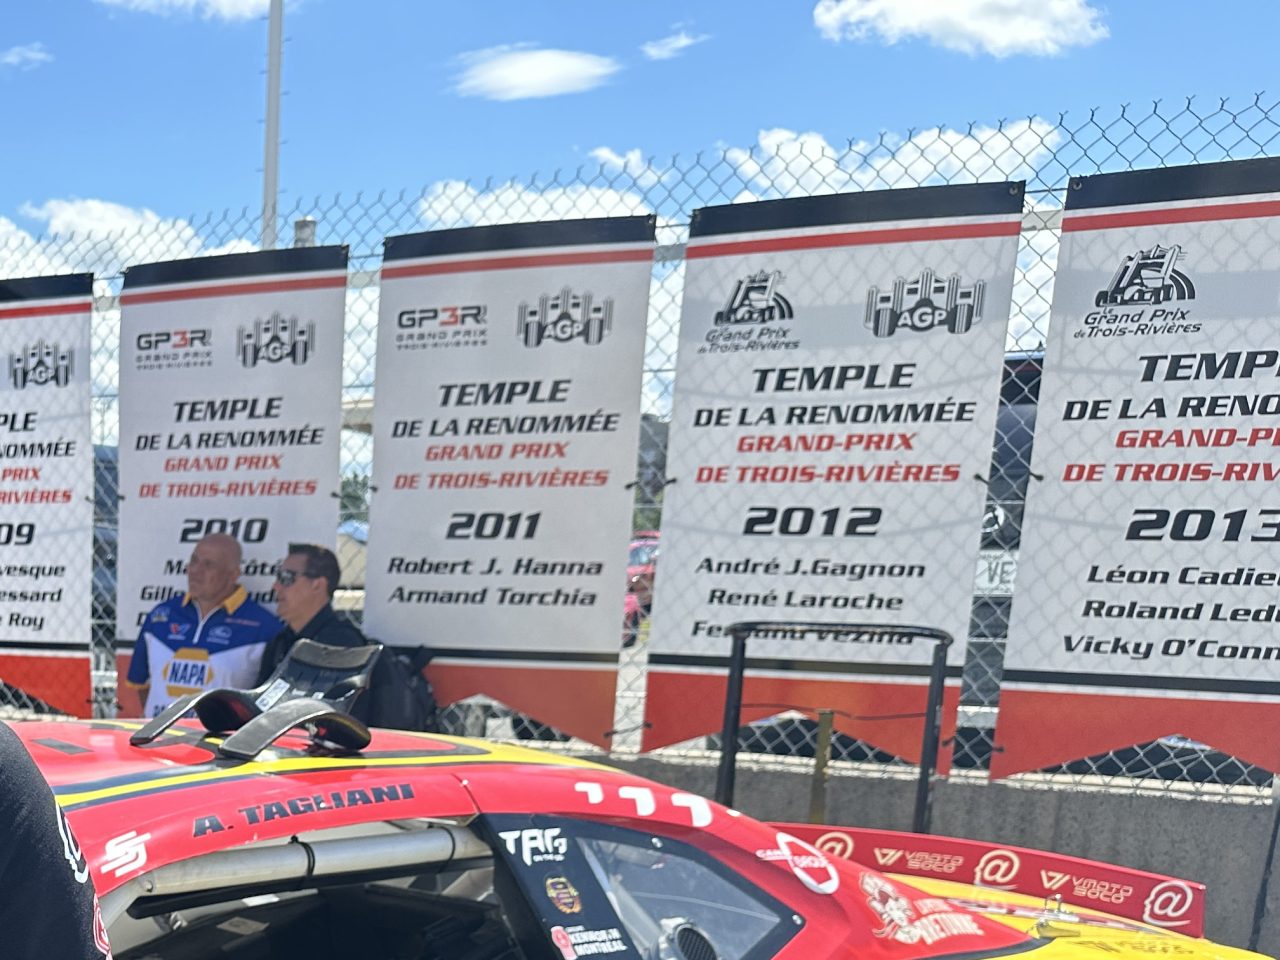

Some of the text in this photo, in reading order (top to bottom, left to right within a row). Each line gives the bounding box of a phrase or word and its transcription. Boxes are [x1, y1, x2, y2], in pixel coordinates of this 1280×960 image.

[898, 309, 947, 328] AGP
[1084, 308, 1190, 326] Grand Prix
[1087, 323, 1202, 337] Trois-Rivières
[1138, 350, 1280, 382] TEMP
[753, 363, 917, 393] TEMPLE
[439, 379, 571, 407] TEMPLE
[173, 397, 284, 423] TEMPLE
[693, 397, 977, 427] DE LA RENOMMÉE
[1062, 400, 1112, 421] DE
[1118, 398, 1167, 419] LA
[391, 409, 620, 438] DE LA RENOMMÉE
[136, 424, 324, 451] DE LA RENOMMÉE
[736, 433, 918, 453] GRAND-PRIX
[164, 453, 283, 473] GRAND PRIX
[425, 441, 570, 462] GRAND PRIX
[1, 466, 42, 481] PRIX
[393, 467, 610, 490] DE TROIS-RIVIÈRES
[695, 460, 960, 483] DE TROIS-RIVIÈRES
[1062, 464, 1106, 482] DE
[139, 477, 318, 498] DE TROIS-RIVIÈRES
[445, 511, 542, 540] 2011
[742, 507, 882, 537] 2012
[1125, 509, 1280, 542] 2013
[387, 557, 604, 577] Robert J. Hanna
[696, 557, 780, 575] André
[1087, 565, 1280, 586] Léon Cadie
[388, 585, 598, 607] Armand Torchia
[708, 589, 904, 611] René Laroche
[9, 612, 45, 631] Roy
[1081, 600, 1204, 621] Roland
[1063, 636, 1154, 660] Vicky
[168, 661, 207, 685] NAPA
[193, 783, 415, 838] A. TAGLIANI
[498, 827, 568, 867] TAG
